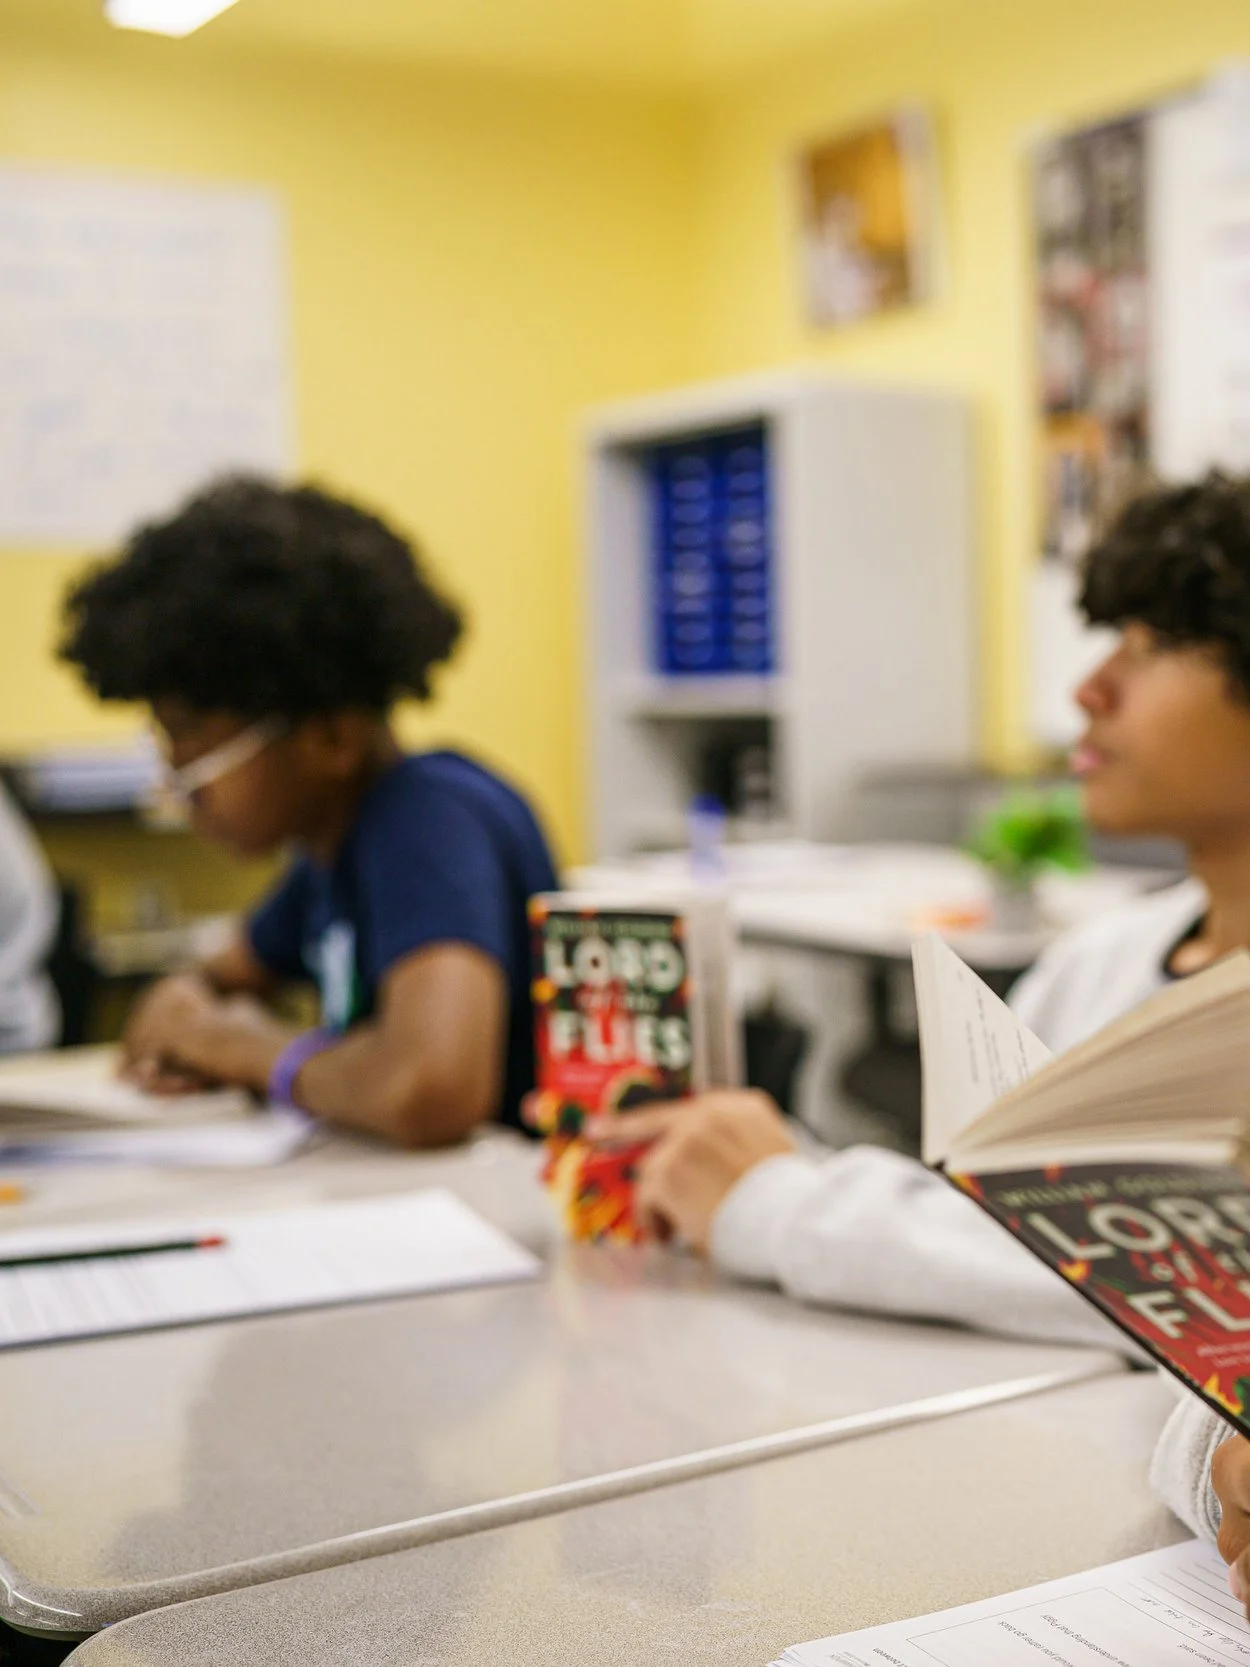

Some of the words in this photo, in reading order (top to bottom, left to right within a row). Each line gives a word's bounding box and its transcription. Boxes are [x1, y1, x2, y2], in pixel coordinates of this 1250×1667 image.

[544, 936, 685, 993] LORD
[548, 1010, 691, 1070] FLIES
[1151, 1248, 1199, 1284] of
